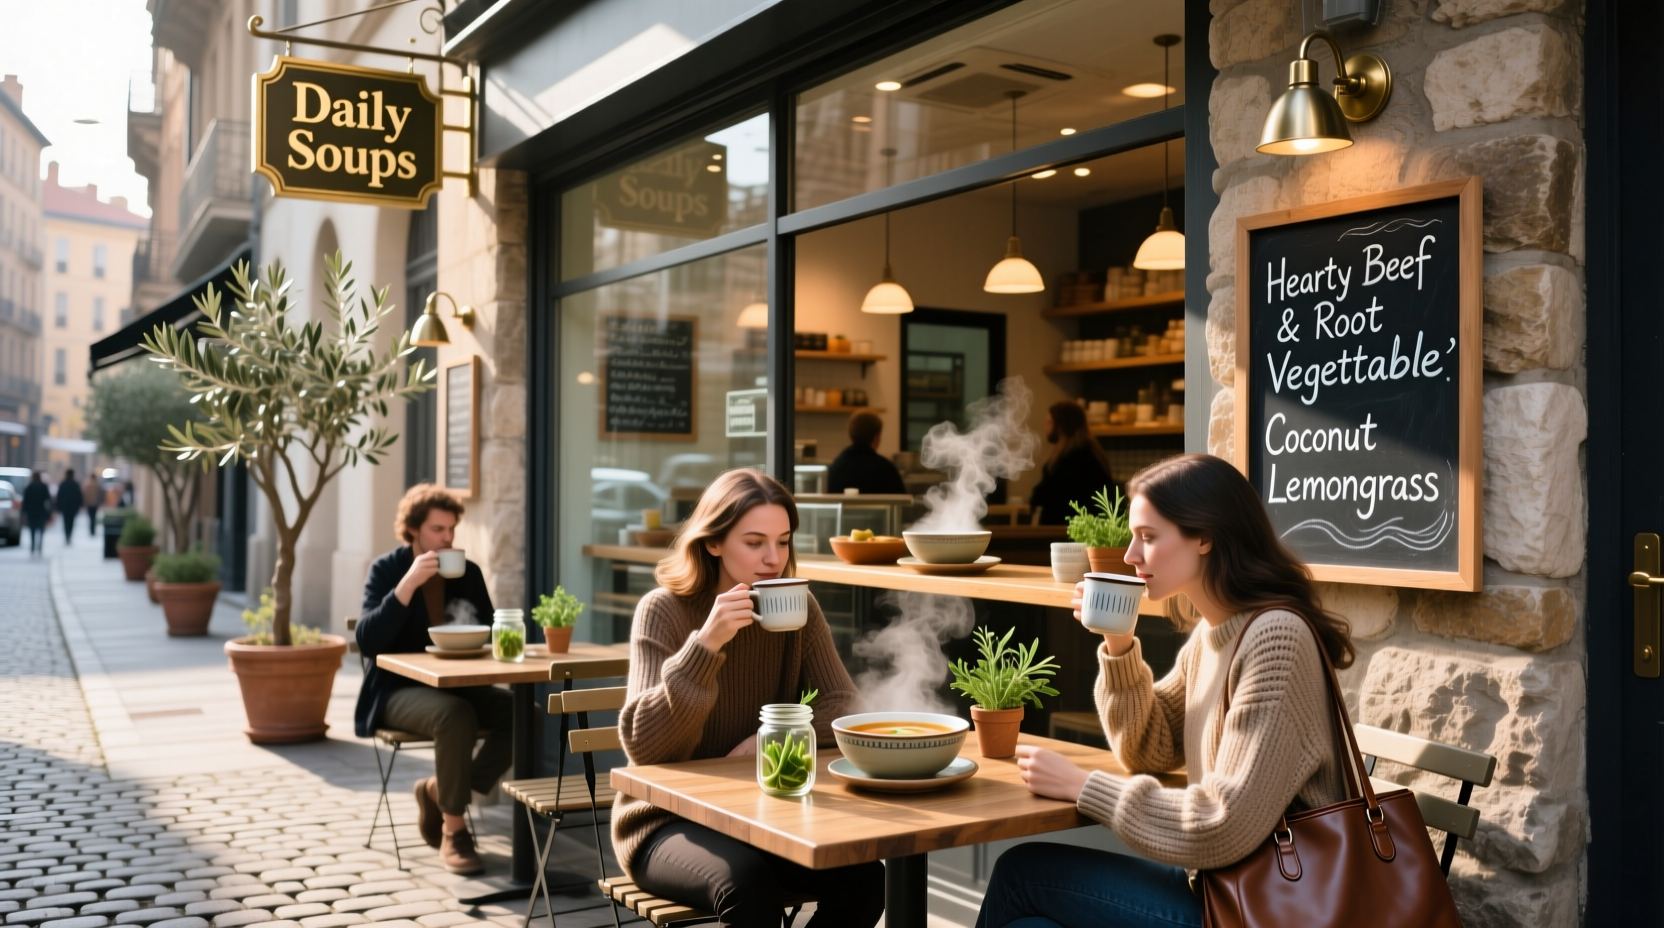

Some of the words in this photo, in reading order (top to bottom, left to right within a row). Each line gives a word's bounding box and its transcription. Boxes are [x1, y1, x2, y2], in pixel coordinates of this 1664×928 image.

[292, 81, 412, 143] Daily
[288, 129, 417, 188] Soups
[618, 175, 709, 223] Soups
[1267, 256, 1352, 303] Hearty
[1362, 234, 1436, 291] Beef
[1276, 307, 1301, 343] &
[1313, 295, 1384, 340] Root
[1265, 412, 1378, 456] Coconut
[1267, 463, 1439, 520] Lemongrass
